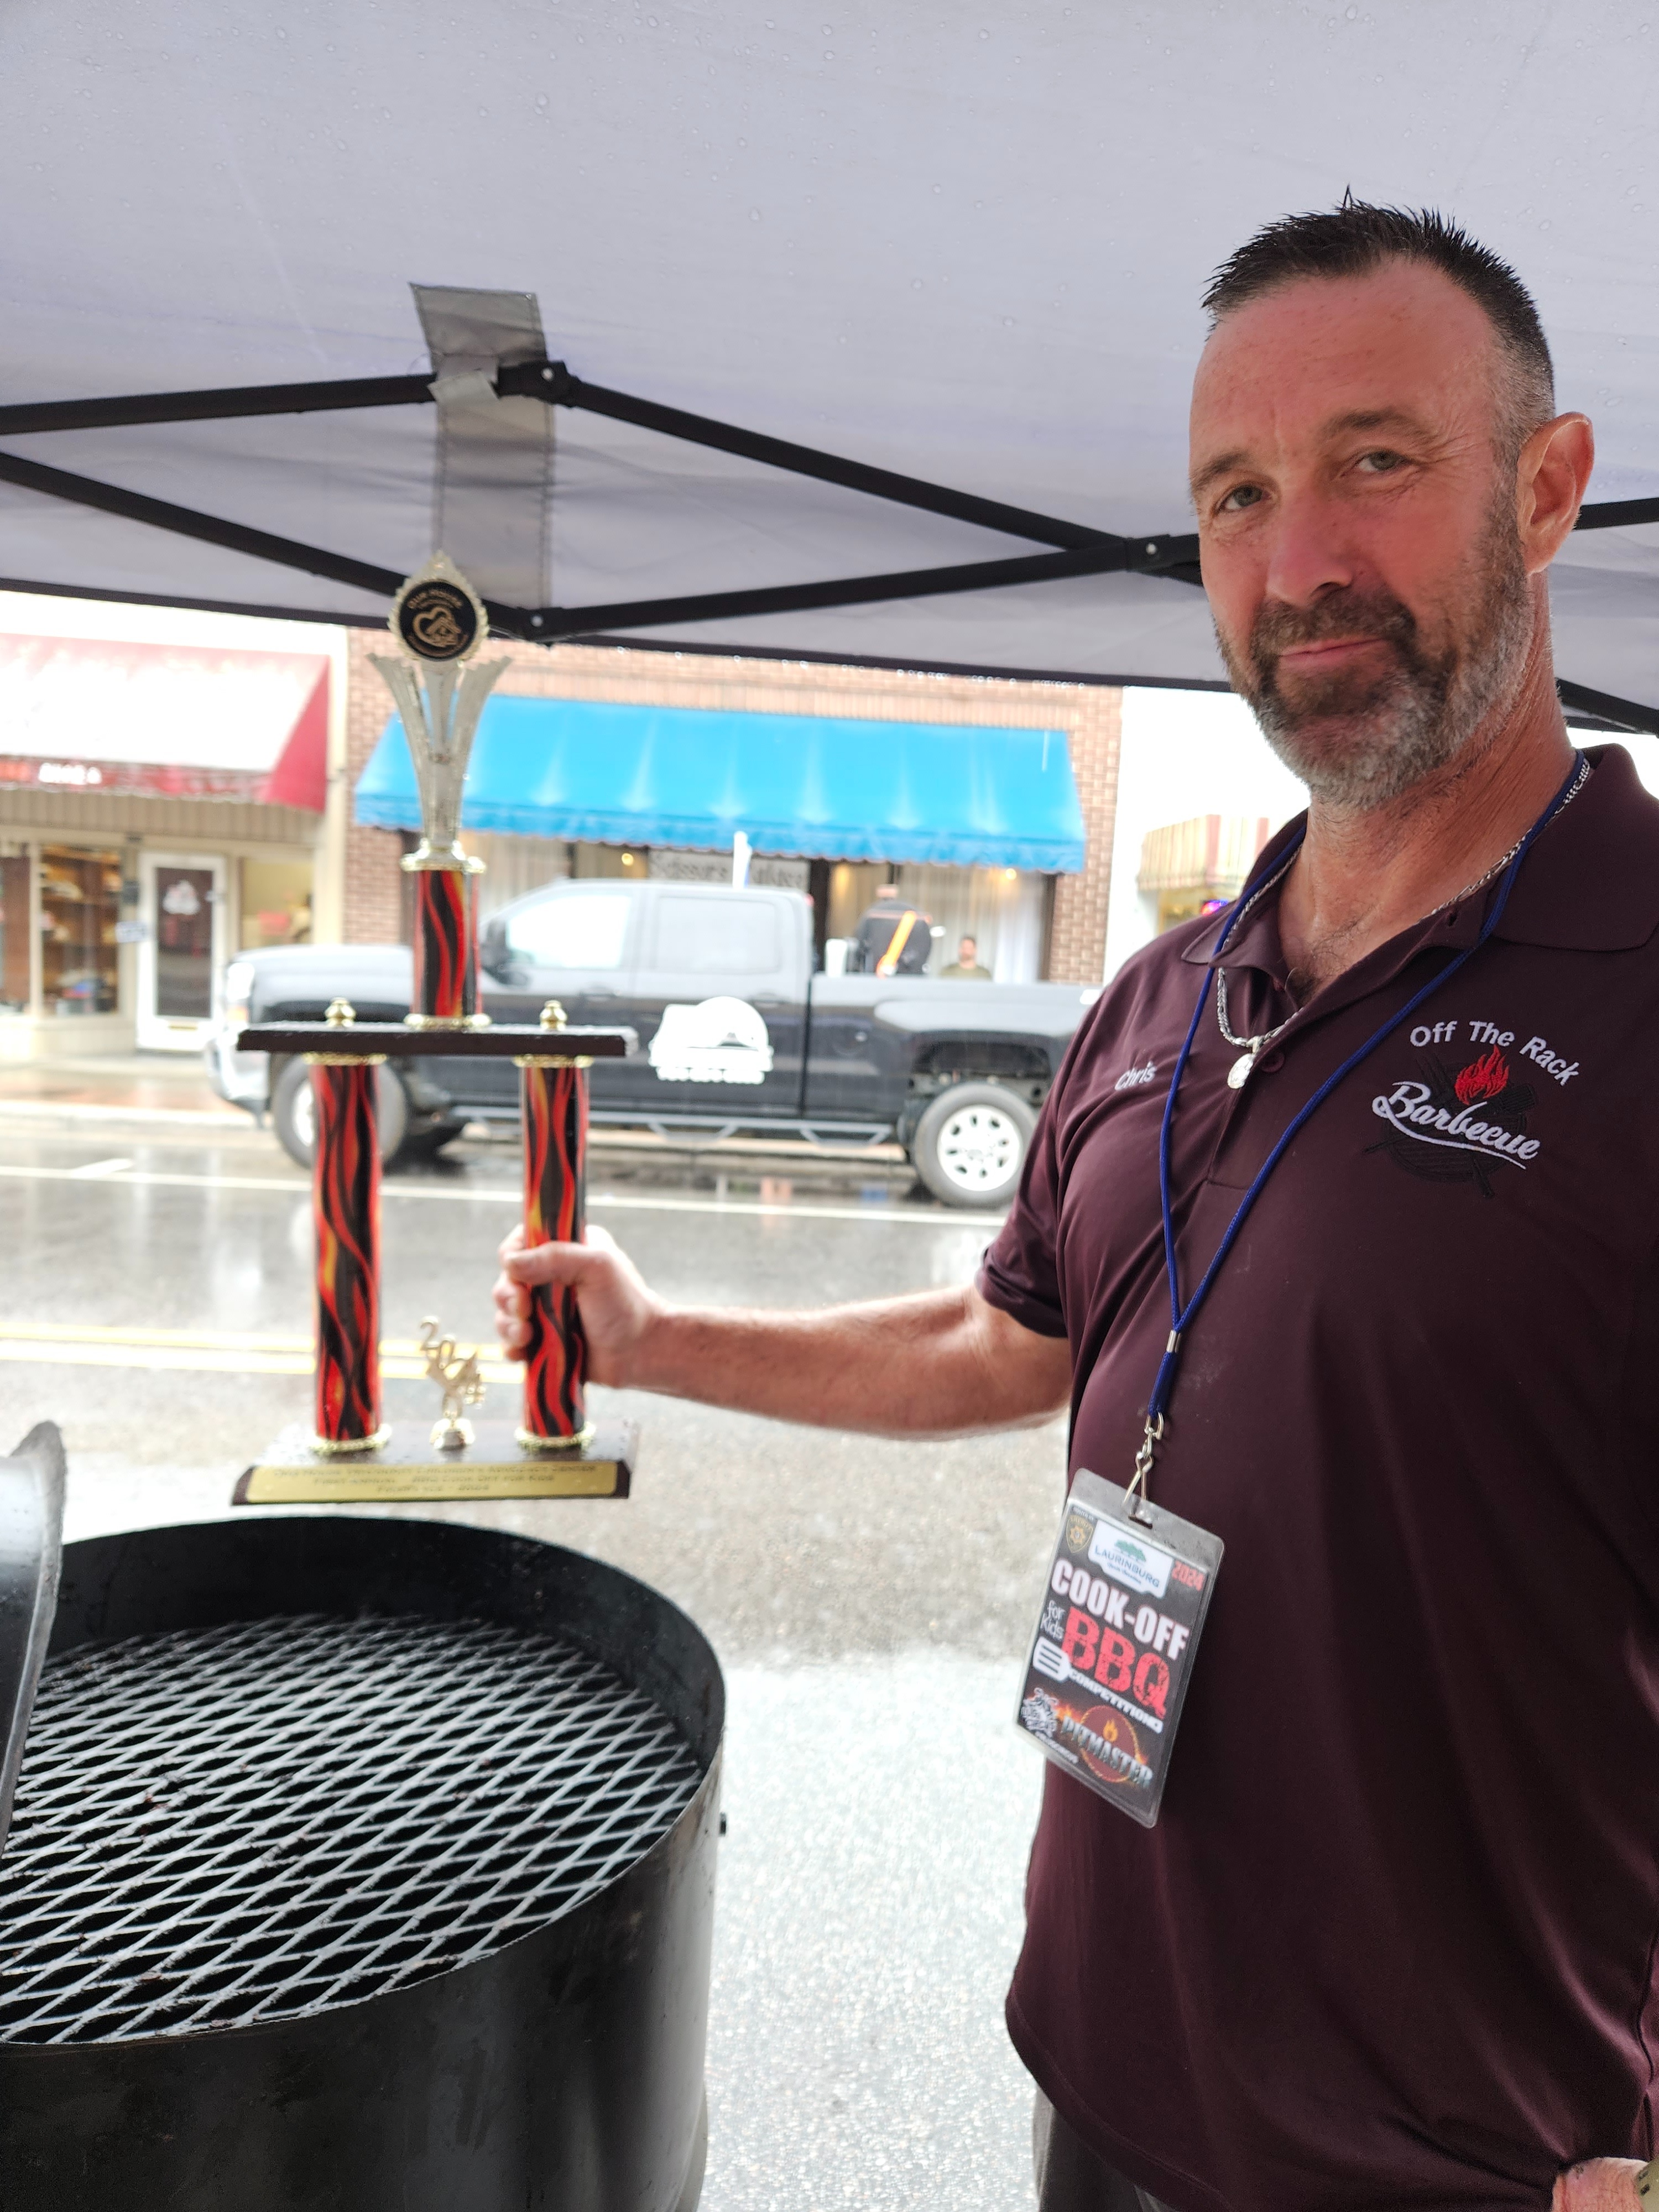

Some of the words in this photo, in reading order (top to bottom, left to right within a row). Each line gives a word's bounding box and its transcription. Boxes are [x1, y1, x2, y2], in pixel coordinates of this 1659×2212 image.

[1114, 1061, 1157, 1091] Chris
[1410, 1020, 1458, 1047] Off
[1469, 1020, 1515, 1047] The
[1519, 1036, 1580, 1086] Rack
[1372, 1081, 1541, 1168] Barbecue
[1094, 1545, 1160, 1588] LAURINBURG
[1172, 1560, 1205, 1592] 2024
[1046, 1599, 1065, 1620] for
[1051, 1558, 1190, 1660] COOK-OFF
[1061, 1605, 1170, 1720] BBQ
[1060, 1715, 1153, 1788] PITMASTER
